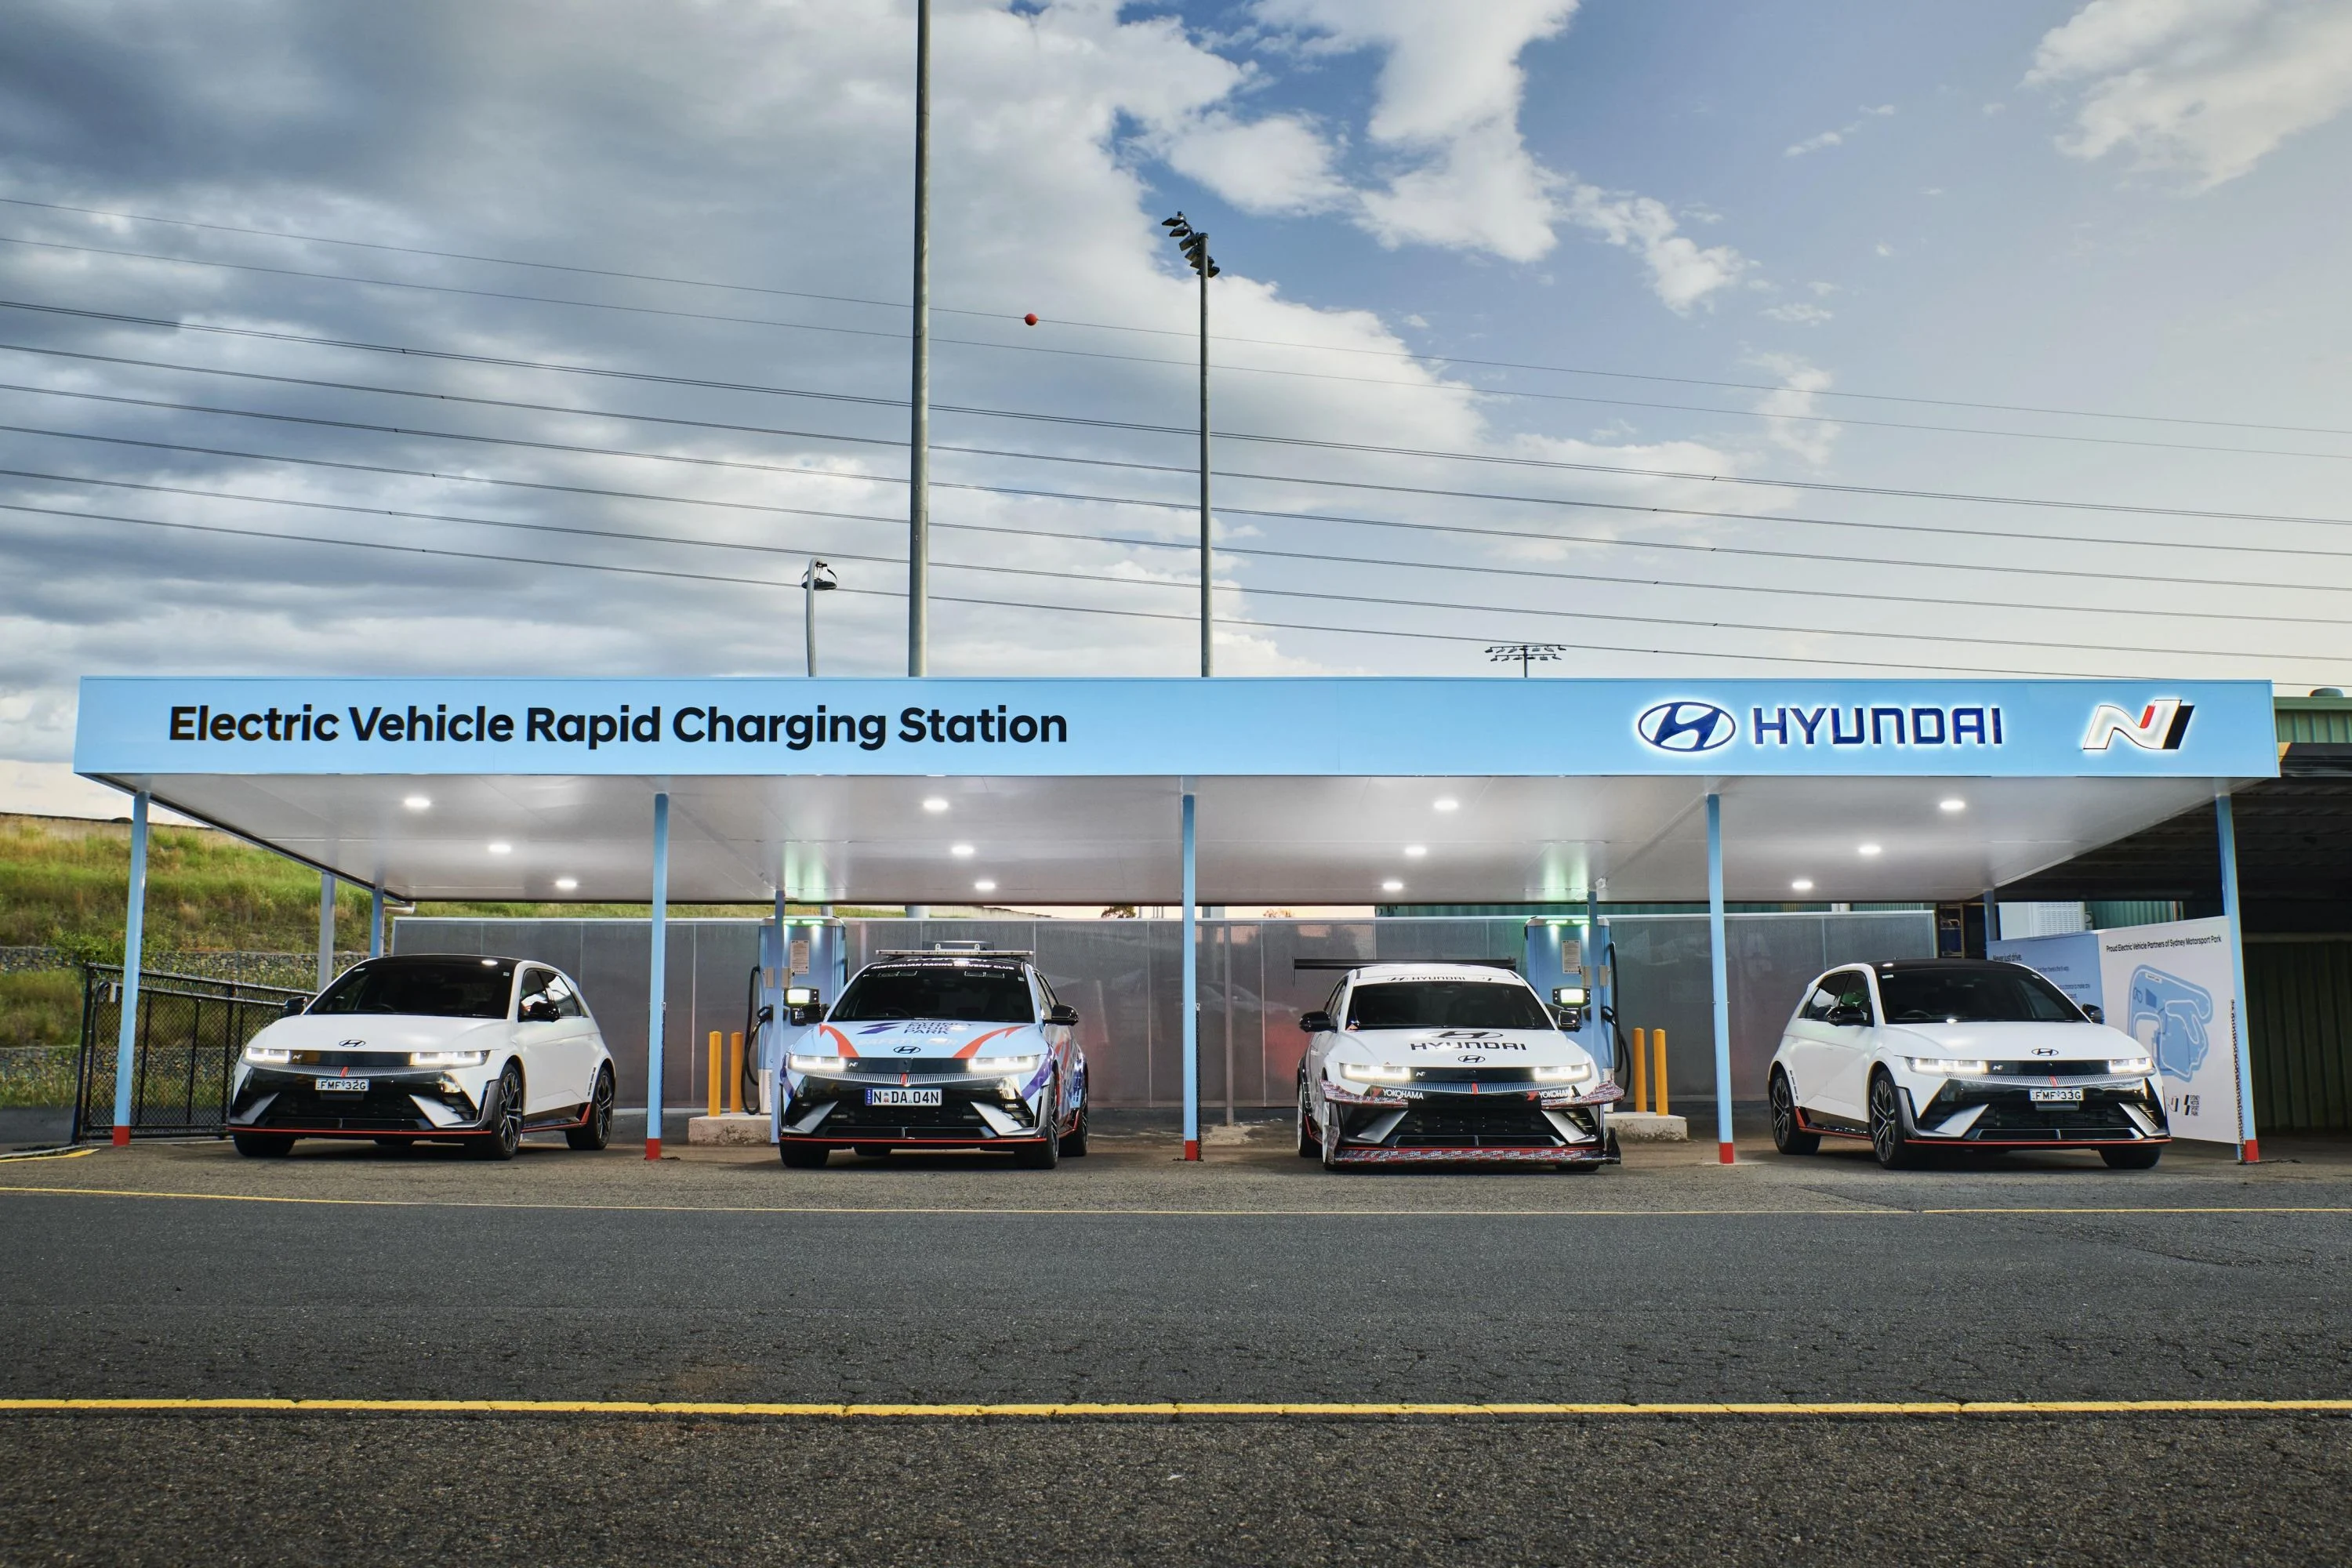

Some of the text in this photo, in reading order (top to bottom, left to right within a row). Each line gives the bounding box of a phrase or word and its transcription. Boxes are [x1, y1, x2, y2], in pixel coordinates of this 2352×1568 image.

[169, 704, 1067, 751] Electric Vehicle Rapid Charging Station
[1753, 707, 2002, 745] HYUNDAI
[2170, 938, 2185, 948] Sydney
[2185, 937, 2210, 946] Motorsport
[2211, 935, 2222, 943] Park
[1410, 1041, 1527, 1051] HYUNDAI
[345, 1081, 366, 1090] 32G
[1382, 1089, 1424, 1100] YOKOHAMA
[2035, 1091, 2056, 1100] FMF
[2060, 1091, 2081, 1100] 33G
